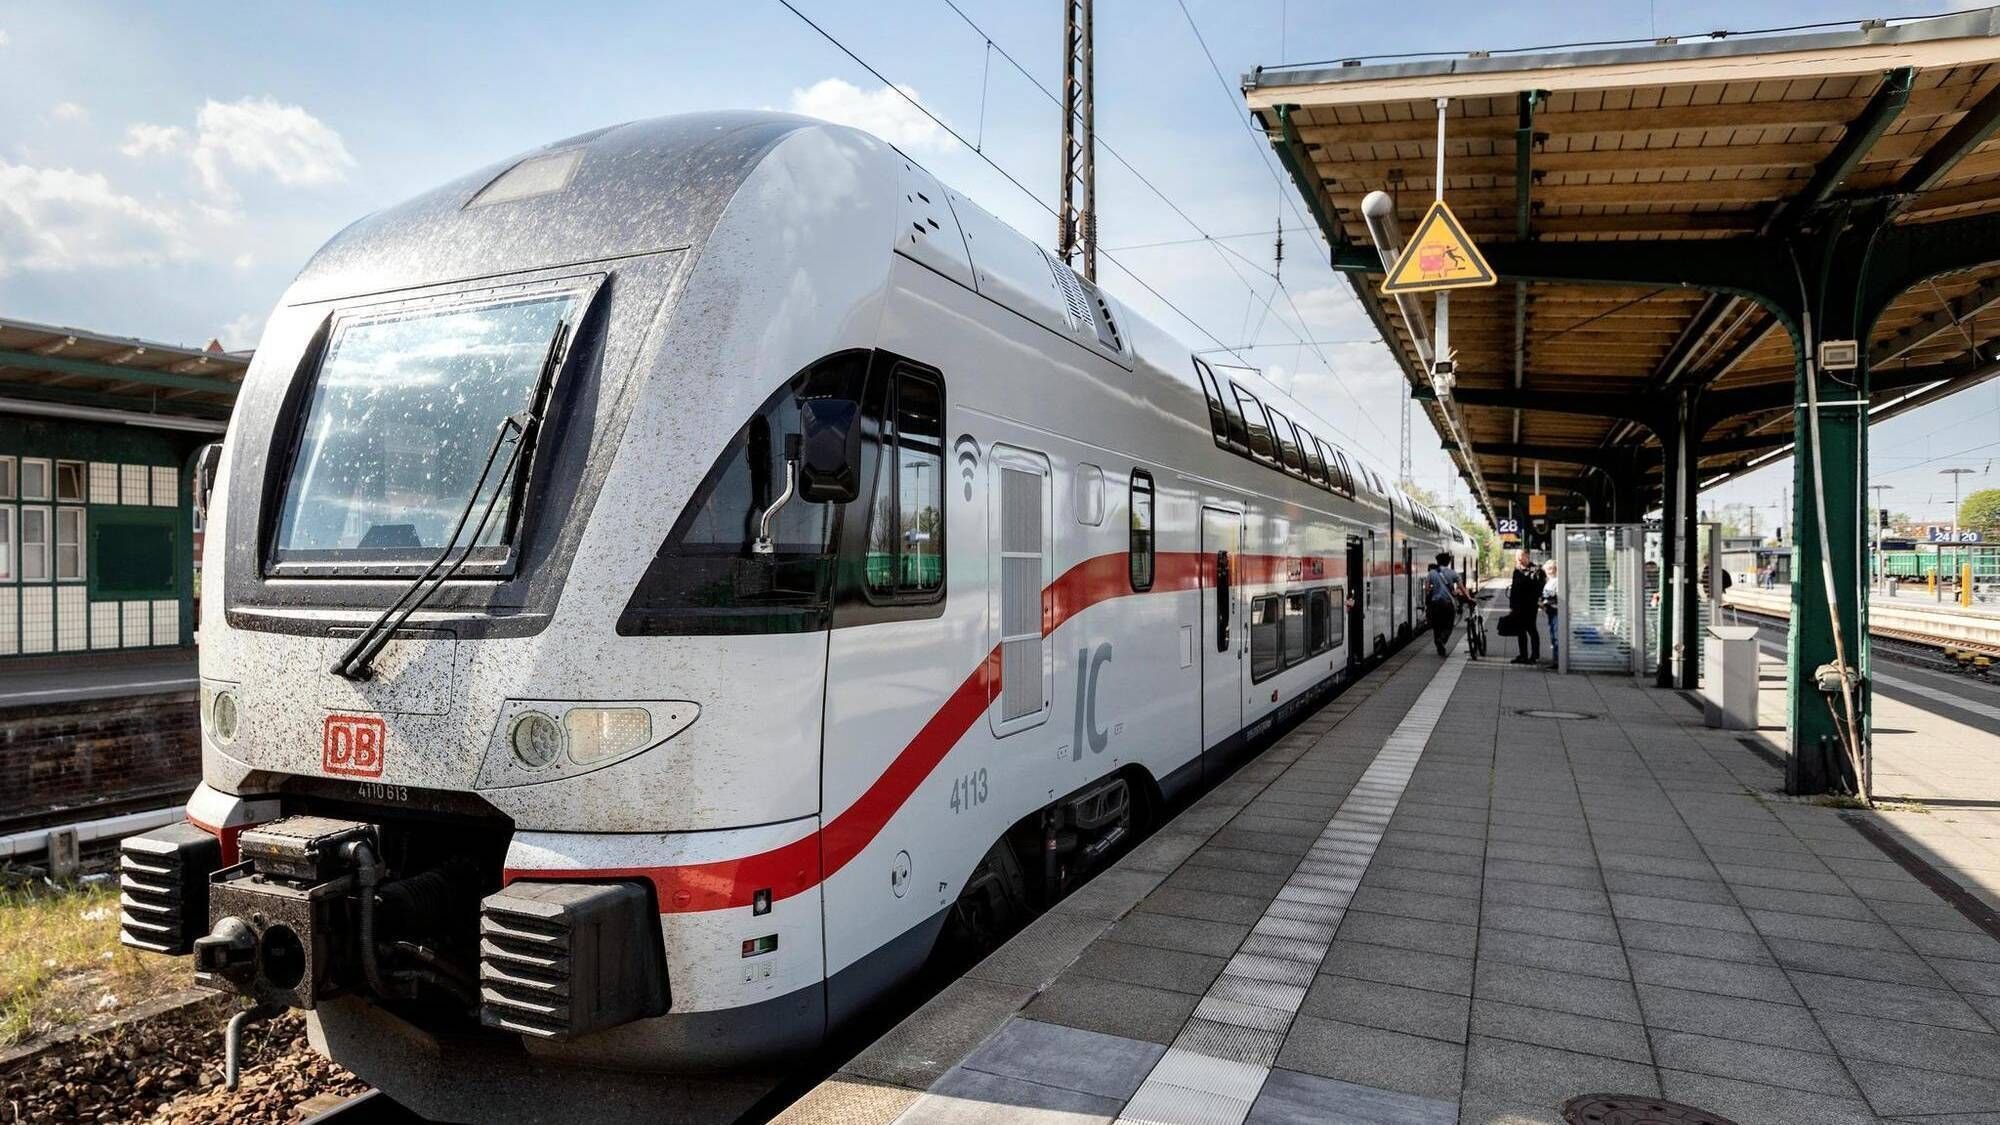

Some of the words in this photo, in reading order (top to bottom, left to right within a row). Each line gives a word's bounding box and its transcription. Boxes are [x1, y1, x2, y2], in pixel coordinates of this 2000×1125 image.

[1500, 519, 1518, 532] 28
[1961, 532, 1978, 542] 20
[1072, 642, 1113, 762] IC
[329, 724, 378, 768] DB
[358, 782, 384, 799] 4110
[386, 785, 408, 802] 613
[950, 767, 989, 814] 4113
